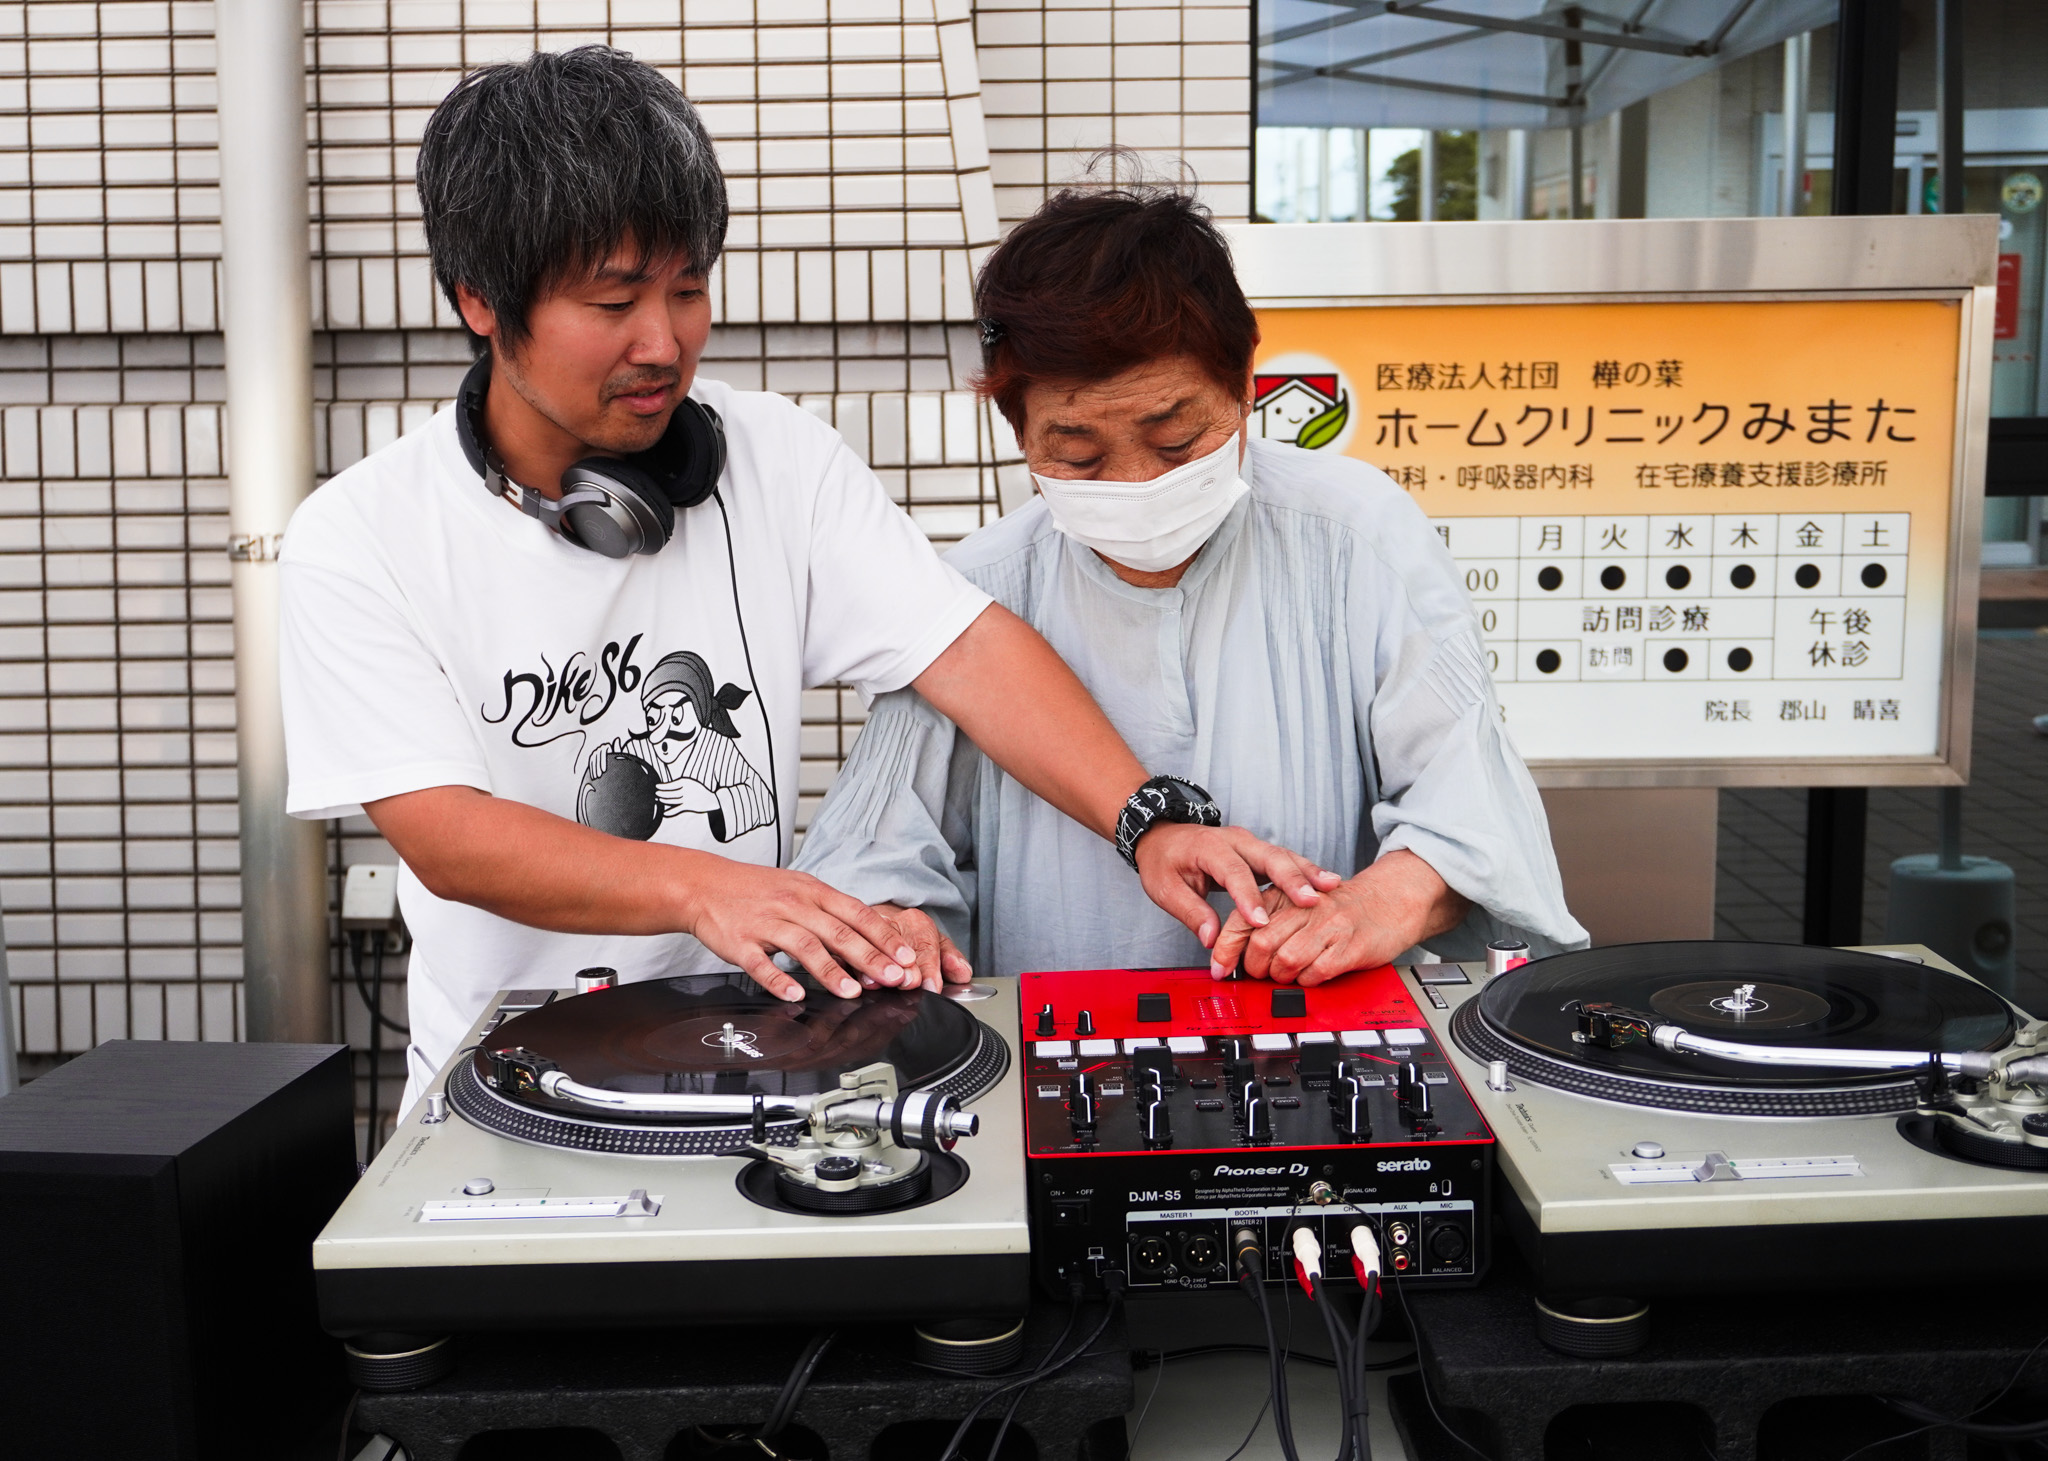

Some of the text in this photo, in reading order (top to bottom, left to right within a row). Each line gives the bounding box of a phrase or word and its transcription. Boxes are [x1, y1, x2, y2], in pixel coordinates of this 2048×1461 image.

[1376, 359, 1684, 391] 医療法人社団 樺の葉
[1376, 399, 1917, 448] ホームクリニックみまた
[1635, 461, 1888, 489] 在宅療養支援診療所
[1537, 520, 1890, 551] 月 火 水 木 金 土
[1582, 605, 1711, 632] 訪問診療
[1809, 608, 1872, 635] 午後
[1589, 647, 1633, 668] 訪問
[1808, 640, 1871, 667] 休診
[1705, 699, 1901, 722] 院長 郡山 晴喜
[1213, 1165, 1286, 1177] Pioneer
[1376, 1157, 1432, 1172] serato
[1129, 1190, 1182, 1203] DJM-S5
